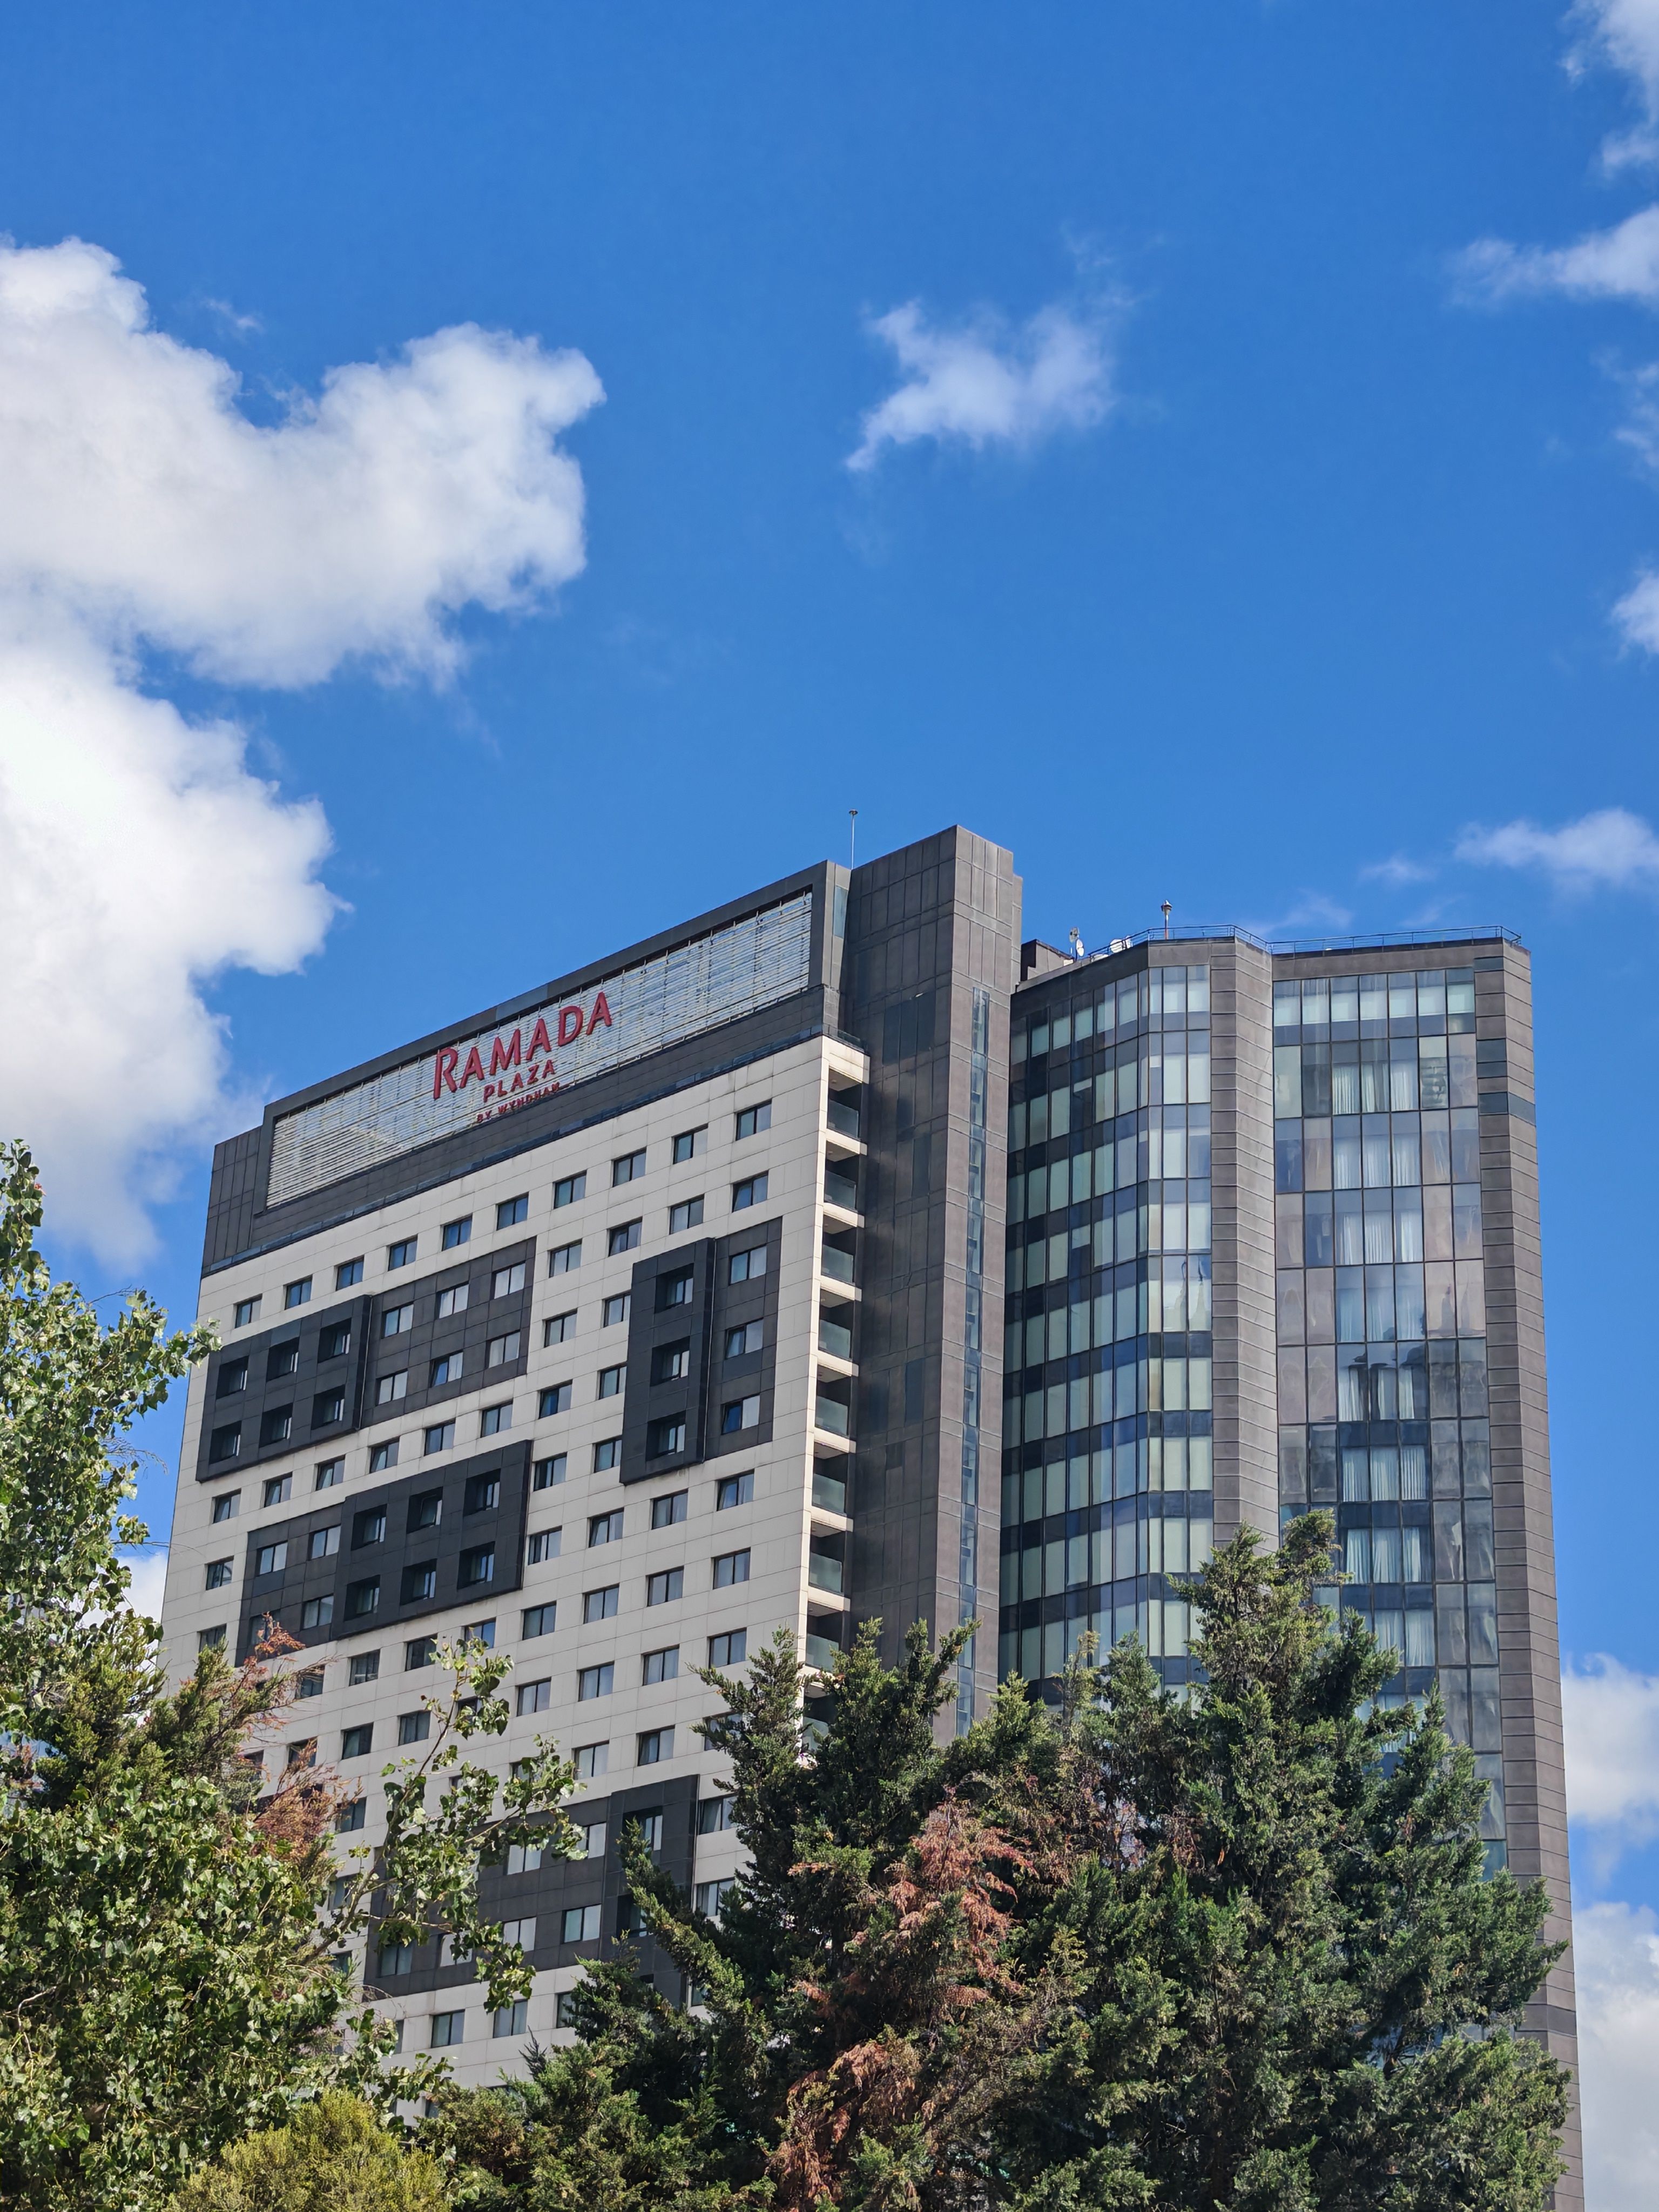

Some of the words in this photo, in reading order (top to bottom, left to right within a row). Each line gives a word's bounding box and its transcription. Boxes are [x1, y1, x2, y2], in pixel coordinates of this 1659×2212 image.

[433, 992, 612, 1100] RAMADA
[476, 1110, 492, 1124] BY
[498, 1082, 560, 1114] WYNDHAM
[483, 1060, 556, 1103] PLAZA
